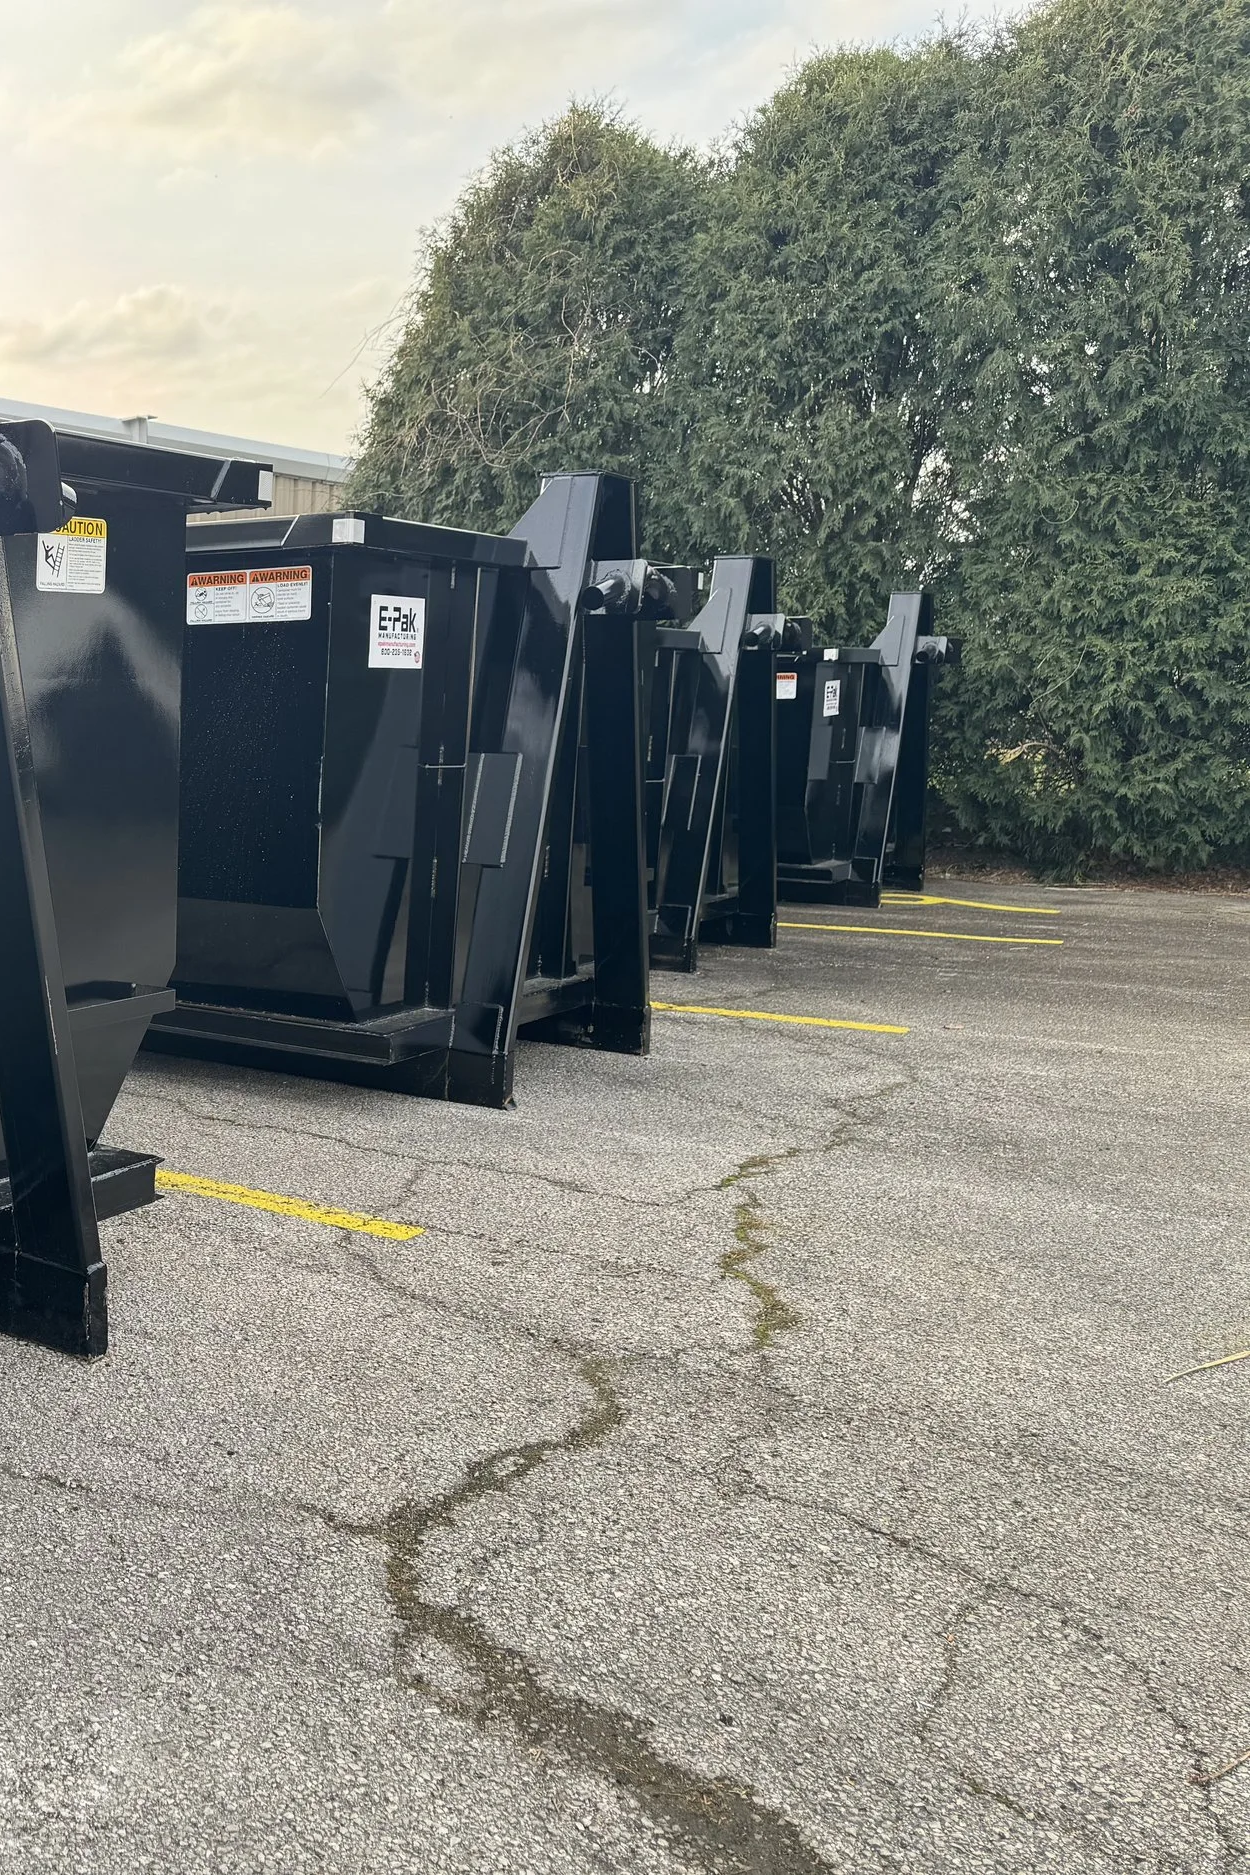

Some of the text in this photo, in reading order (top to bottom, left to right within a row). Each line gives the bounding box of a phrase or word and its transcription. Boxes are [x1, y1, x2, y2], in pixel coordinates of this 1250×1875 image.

[197, 574, 244, 585] WARNING
[259, 569, 308, 581] WARNING
[378, 605, 417, 633] E-Pak
[377, 632, 417, 640] MANUFACTURING
